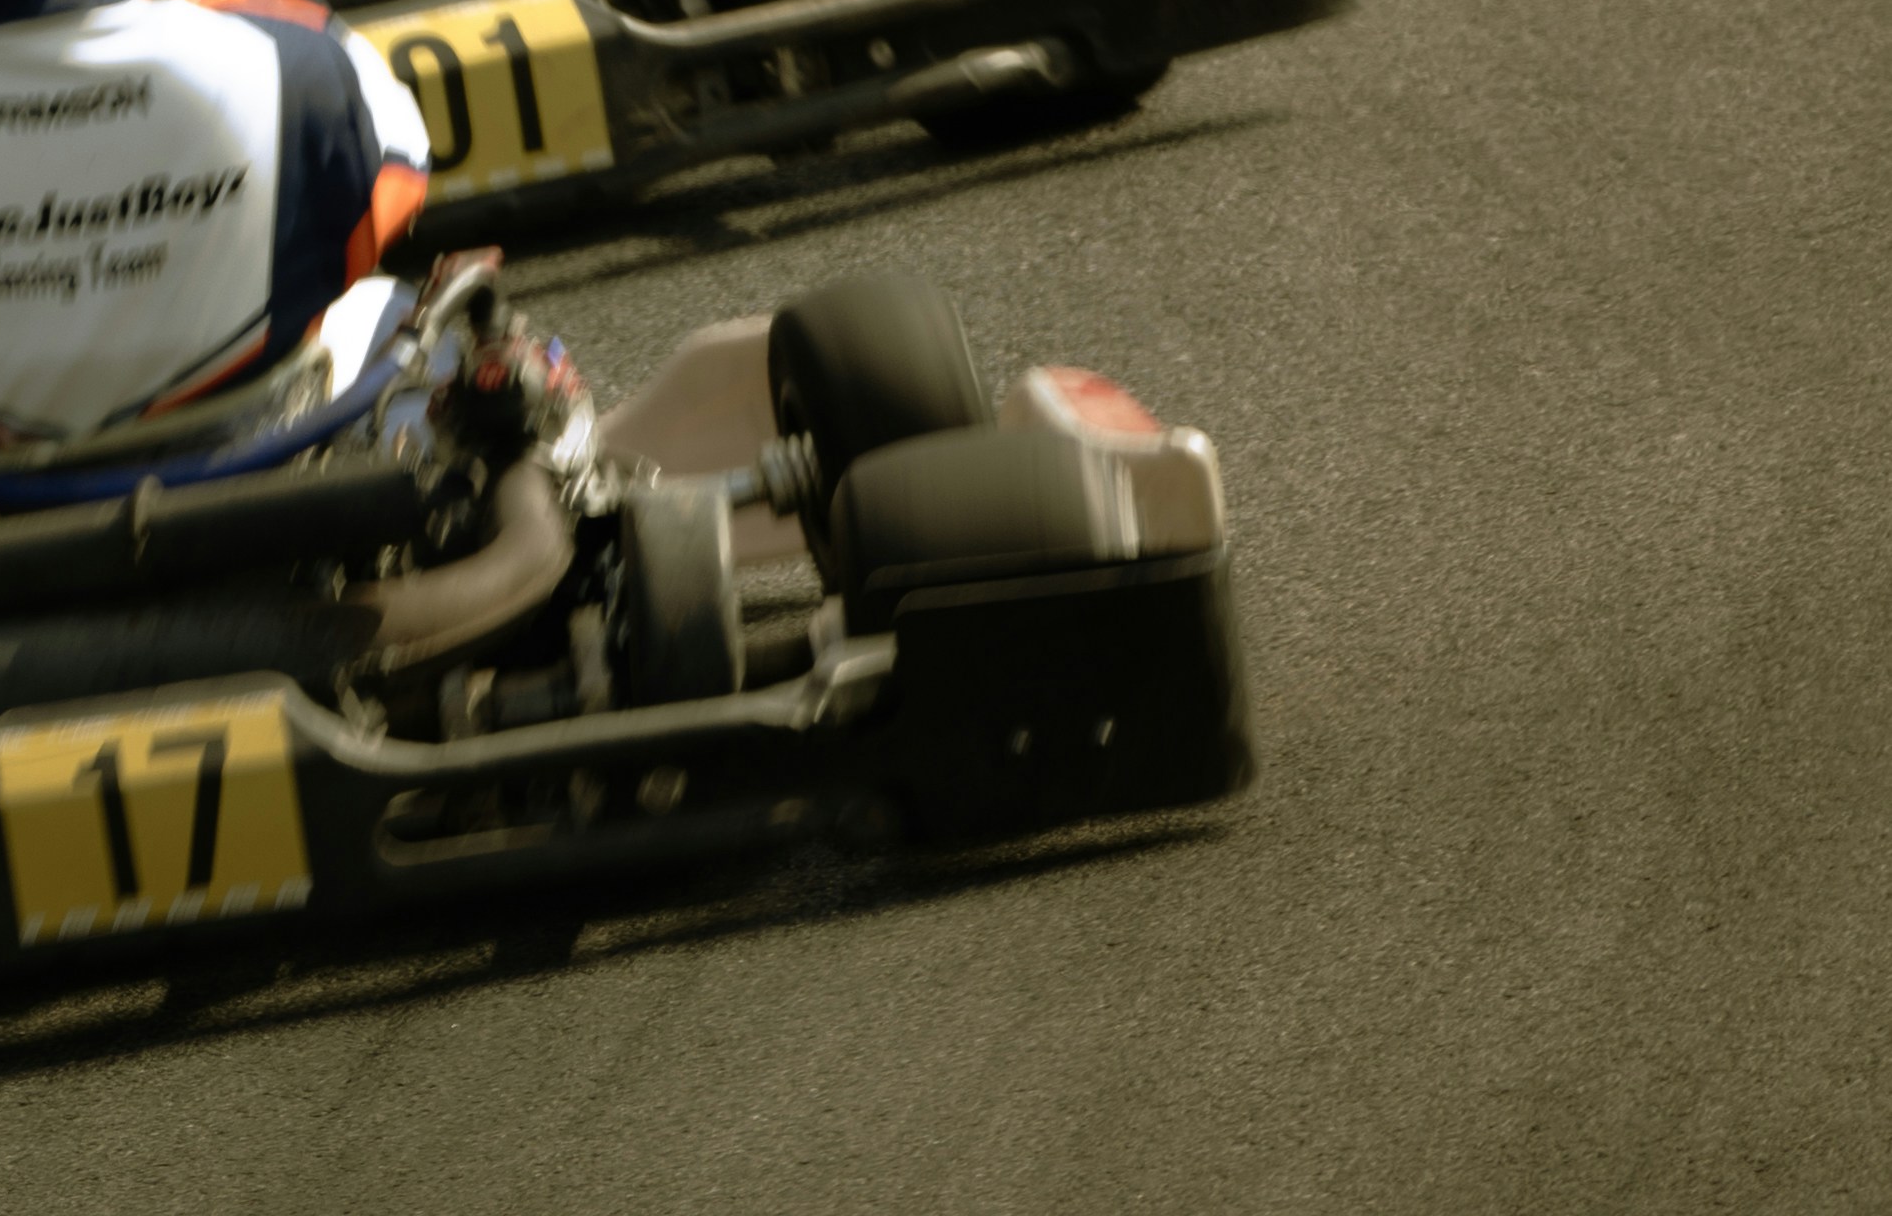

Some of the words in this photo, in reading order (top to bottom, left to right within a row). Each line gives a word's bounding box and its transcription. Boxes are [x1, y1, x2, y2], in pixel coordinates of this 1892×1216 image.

[388, 13, 545, 176] 01
[85, 239, 169, 290] Team
[70, 721, 230, 900] 17
